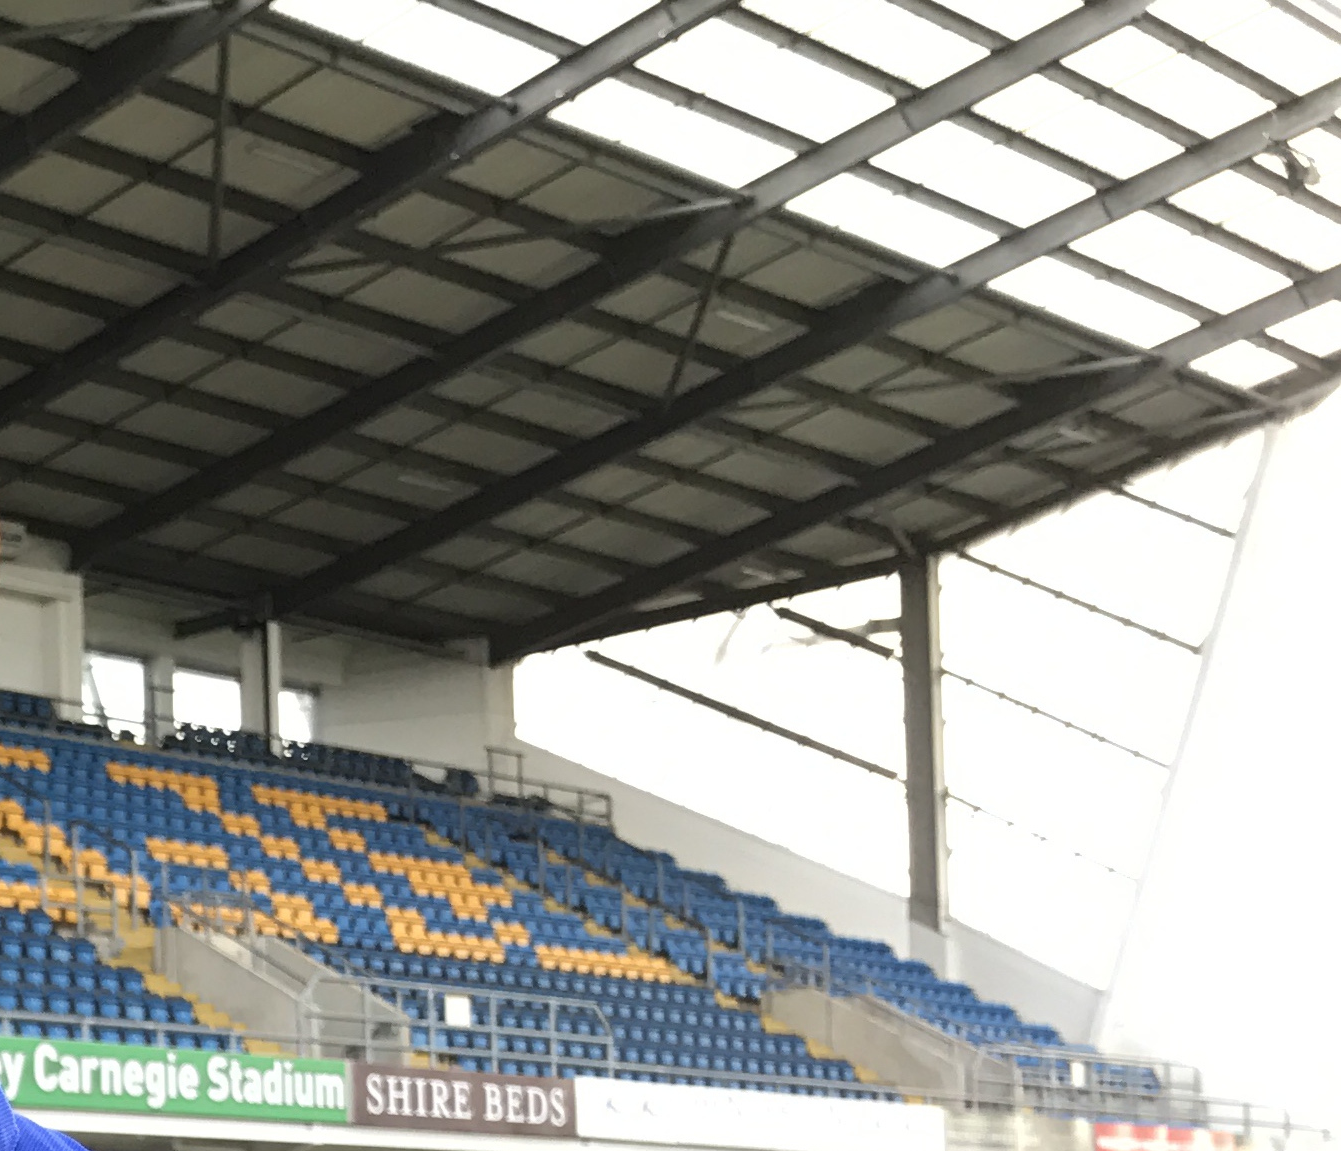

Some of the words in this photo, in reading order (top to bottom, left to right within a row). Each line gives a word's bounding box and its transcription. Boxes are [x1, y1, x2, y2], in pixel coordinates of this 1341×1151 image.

[33, 1043, 199, 1109] Carnegie
[206, 1054, 345, 1109] Stadium
[366, 1072, 473, 1120] SHIRE
[484, 1081, 566, 1128] BEDS
